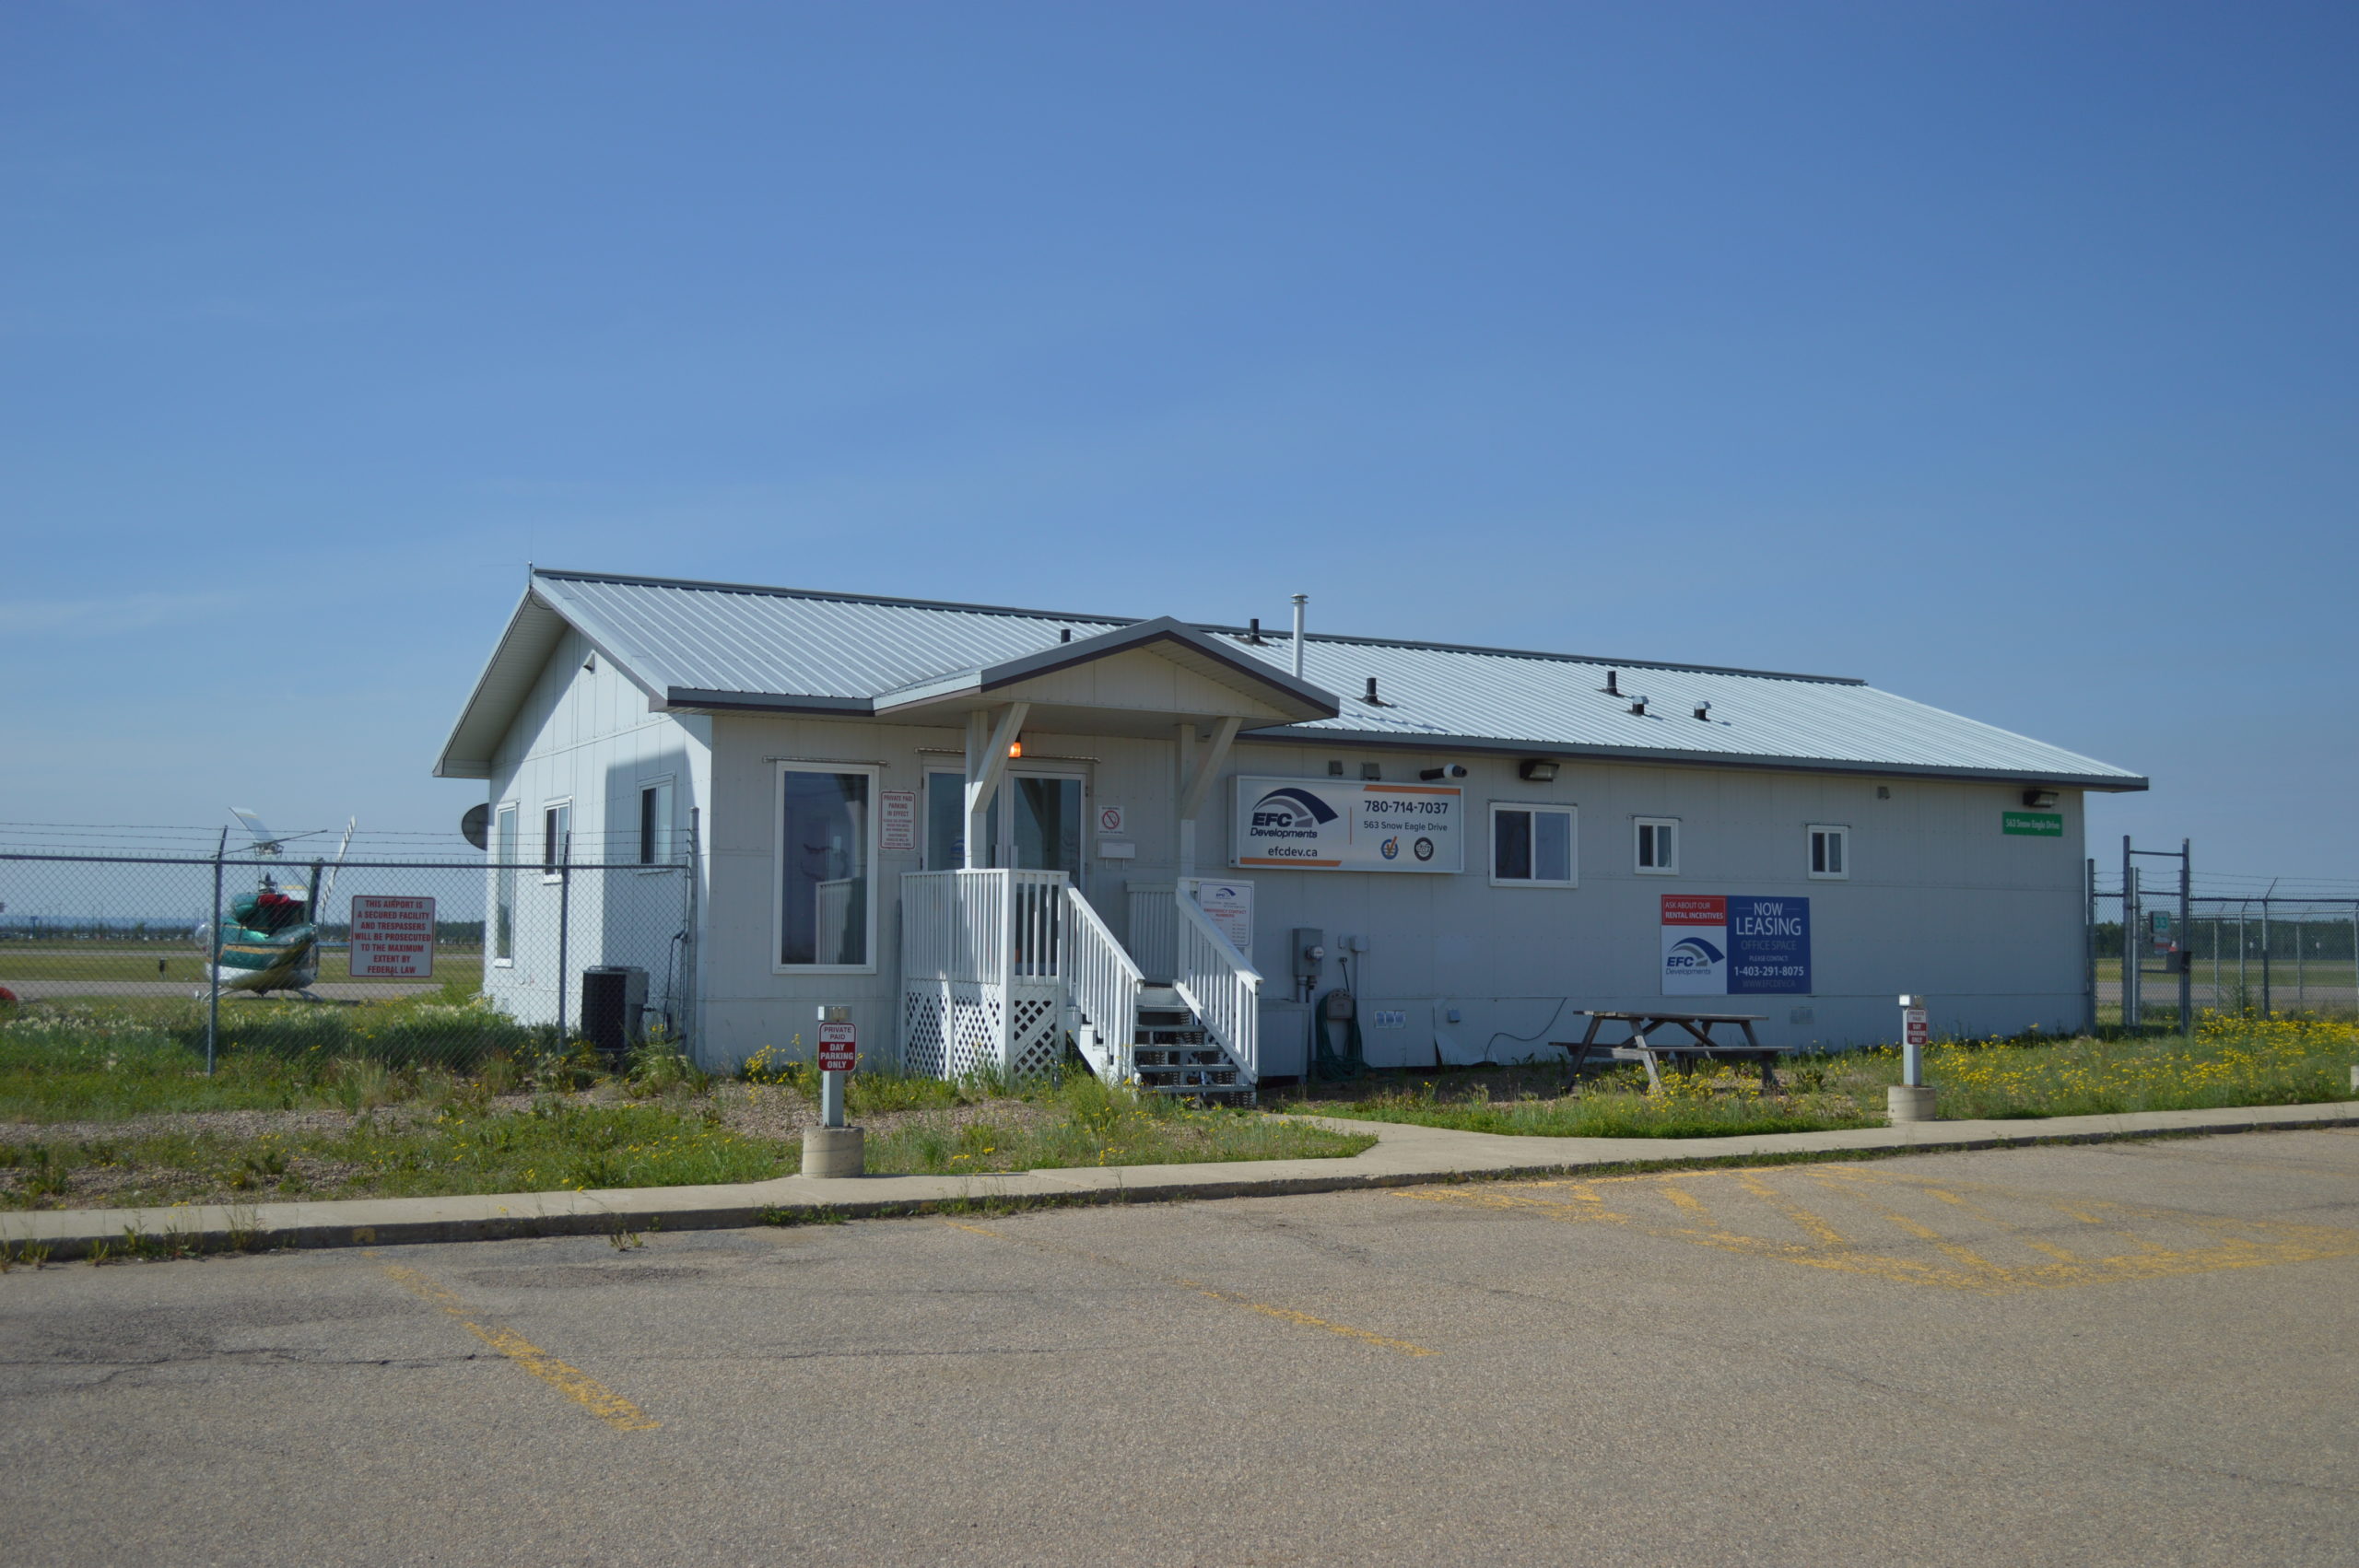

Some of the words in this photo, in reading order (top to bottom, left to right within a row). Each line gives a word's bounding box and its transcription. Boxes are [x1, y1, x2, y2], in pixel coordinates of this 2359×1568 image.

[1364, 800, 1449, 813] 780-714-7037
[1251, 813, 1293, 827] EFC
[2017, 819, 2031, 827] Snow
[2032, 820, 2045, 831] Eagle
[2047, 820, 2060, 829] Drive
[1364, 820, 1379, 829] 563
[1381, 821, 1402, 830] Snow
[1404, 823, 1426, 833] Eagle
[1428, 823, 1448, 831] Drive
[1250, 827, 1318, 839] Developments
[1268, 846, 1318, 857] efcdev.ca
[1754, 903, 1783, 916] NOW
[378, 922, 426, 930] TRESPASSERS
[1736, 918, 1802, 935] LEASING
[2154, 917, 2168, 929] 33
[355, 932, 371, 941] WILL
[385, 933, 431, 942] PROSECUTED
[1741, 940, 1769, 951] OFFICE
[1772, 941, 1797, 951] SPACE
[373, 954, 399, 963] EXTENT
[1667, 956, 1694, 966] EFC
[1734, 966, 1804, 976] 1-403-291-8075
